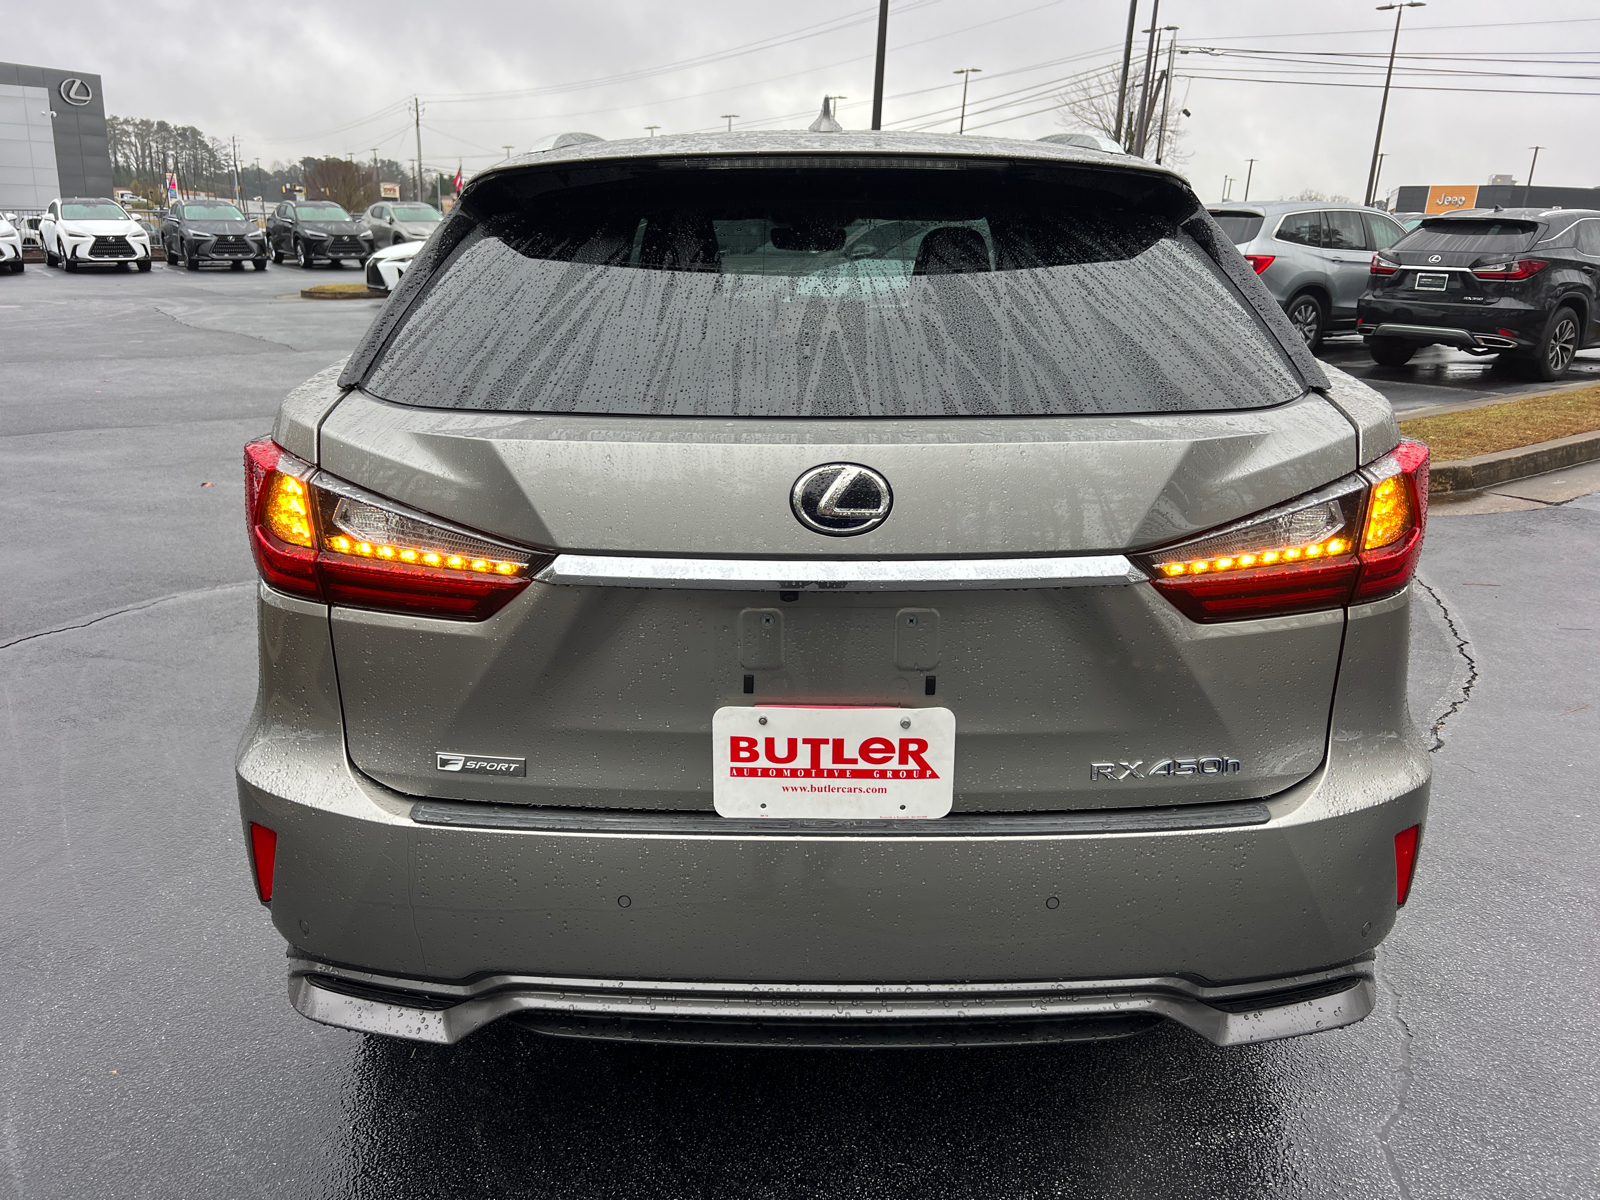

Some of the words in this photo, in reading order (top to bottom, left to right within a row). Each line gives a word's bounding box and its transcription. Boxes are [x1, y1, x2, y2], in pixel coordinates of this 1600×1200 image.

[1437, 193, 1465, 207] Jeep
[465, 761, 519, 772] SPORT
[1090, 760, 1145, 781] RX
[1149, 755, 1240, 777] 450h
[731, 768, 852, 778] AUTOMOTIVE
[873, 769, 932, 778] GROUP
[782, 784, 887, 794] www.butlercars.com
